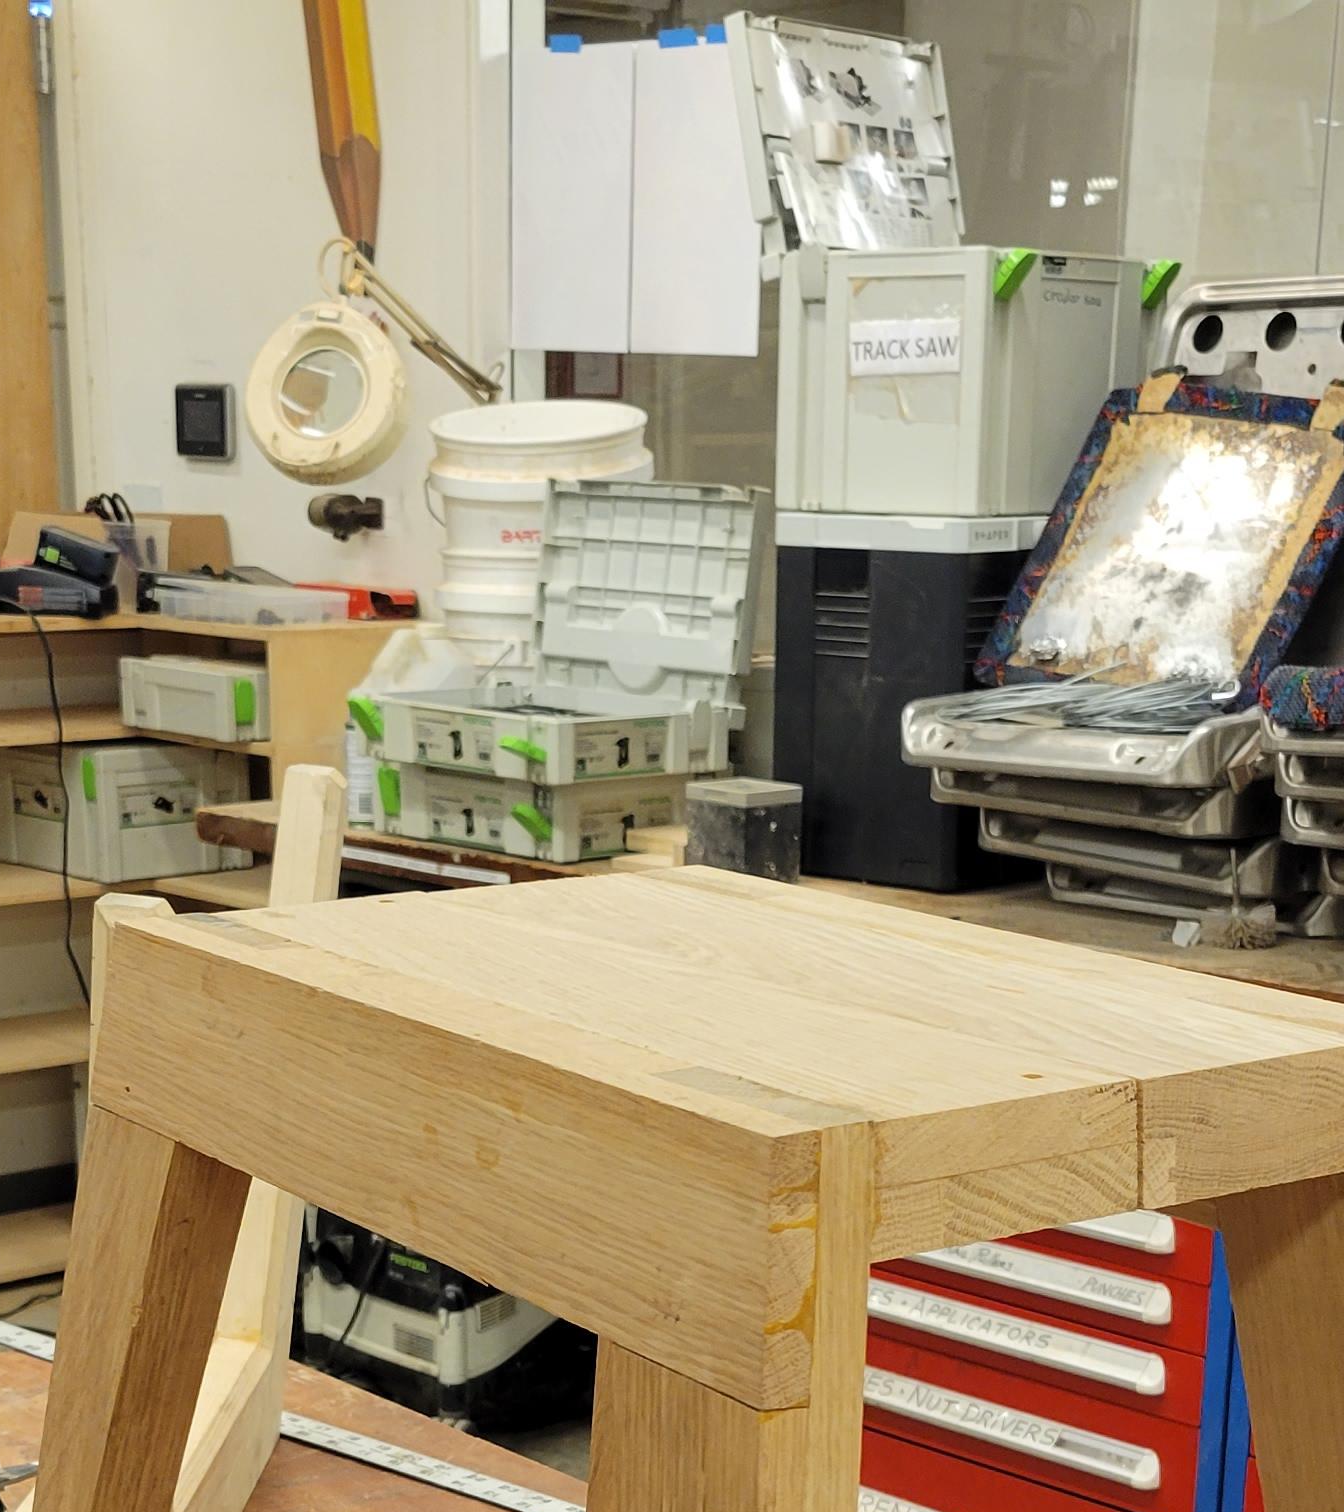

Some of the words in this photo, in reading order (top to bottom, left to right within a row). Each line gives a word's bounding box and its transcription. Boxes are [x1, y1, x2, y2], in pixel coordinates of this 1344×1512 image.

[852, 338, 910, 362] TRACK
[914, 335, 958, 360] SAW
[1079, 1276, 1147, 1307] PUNCHES
[909, 1295, 1054, 1350] APPLICATORS
[906, 1384, 953, 1419] NUT
